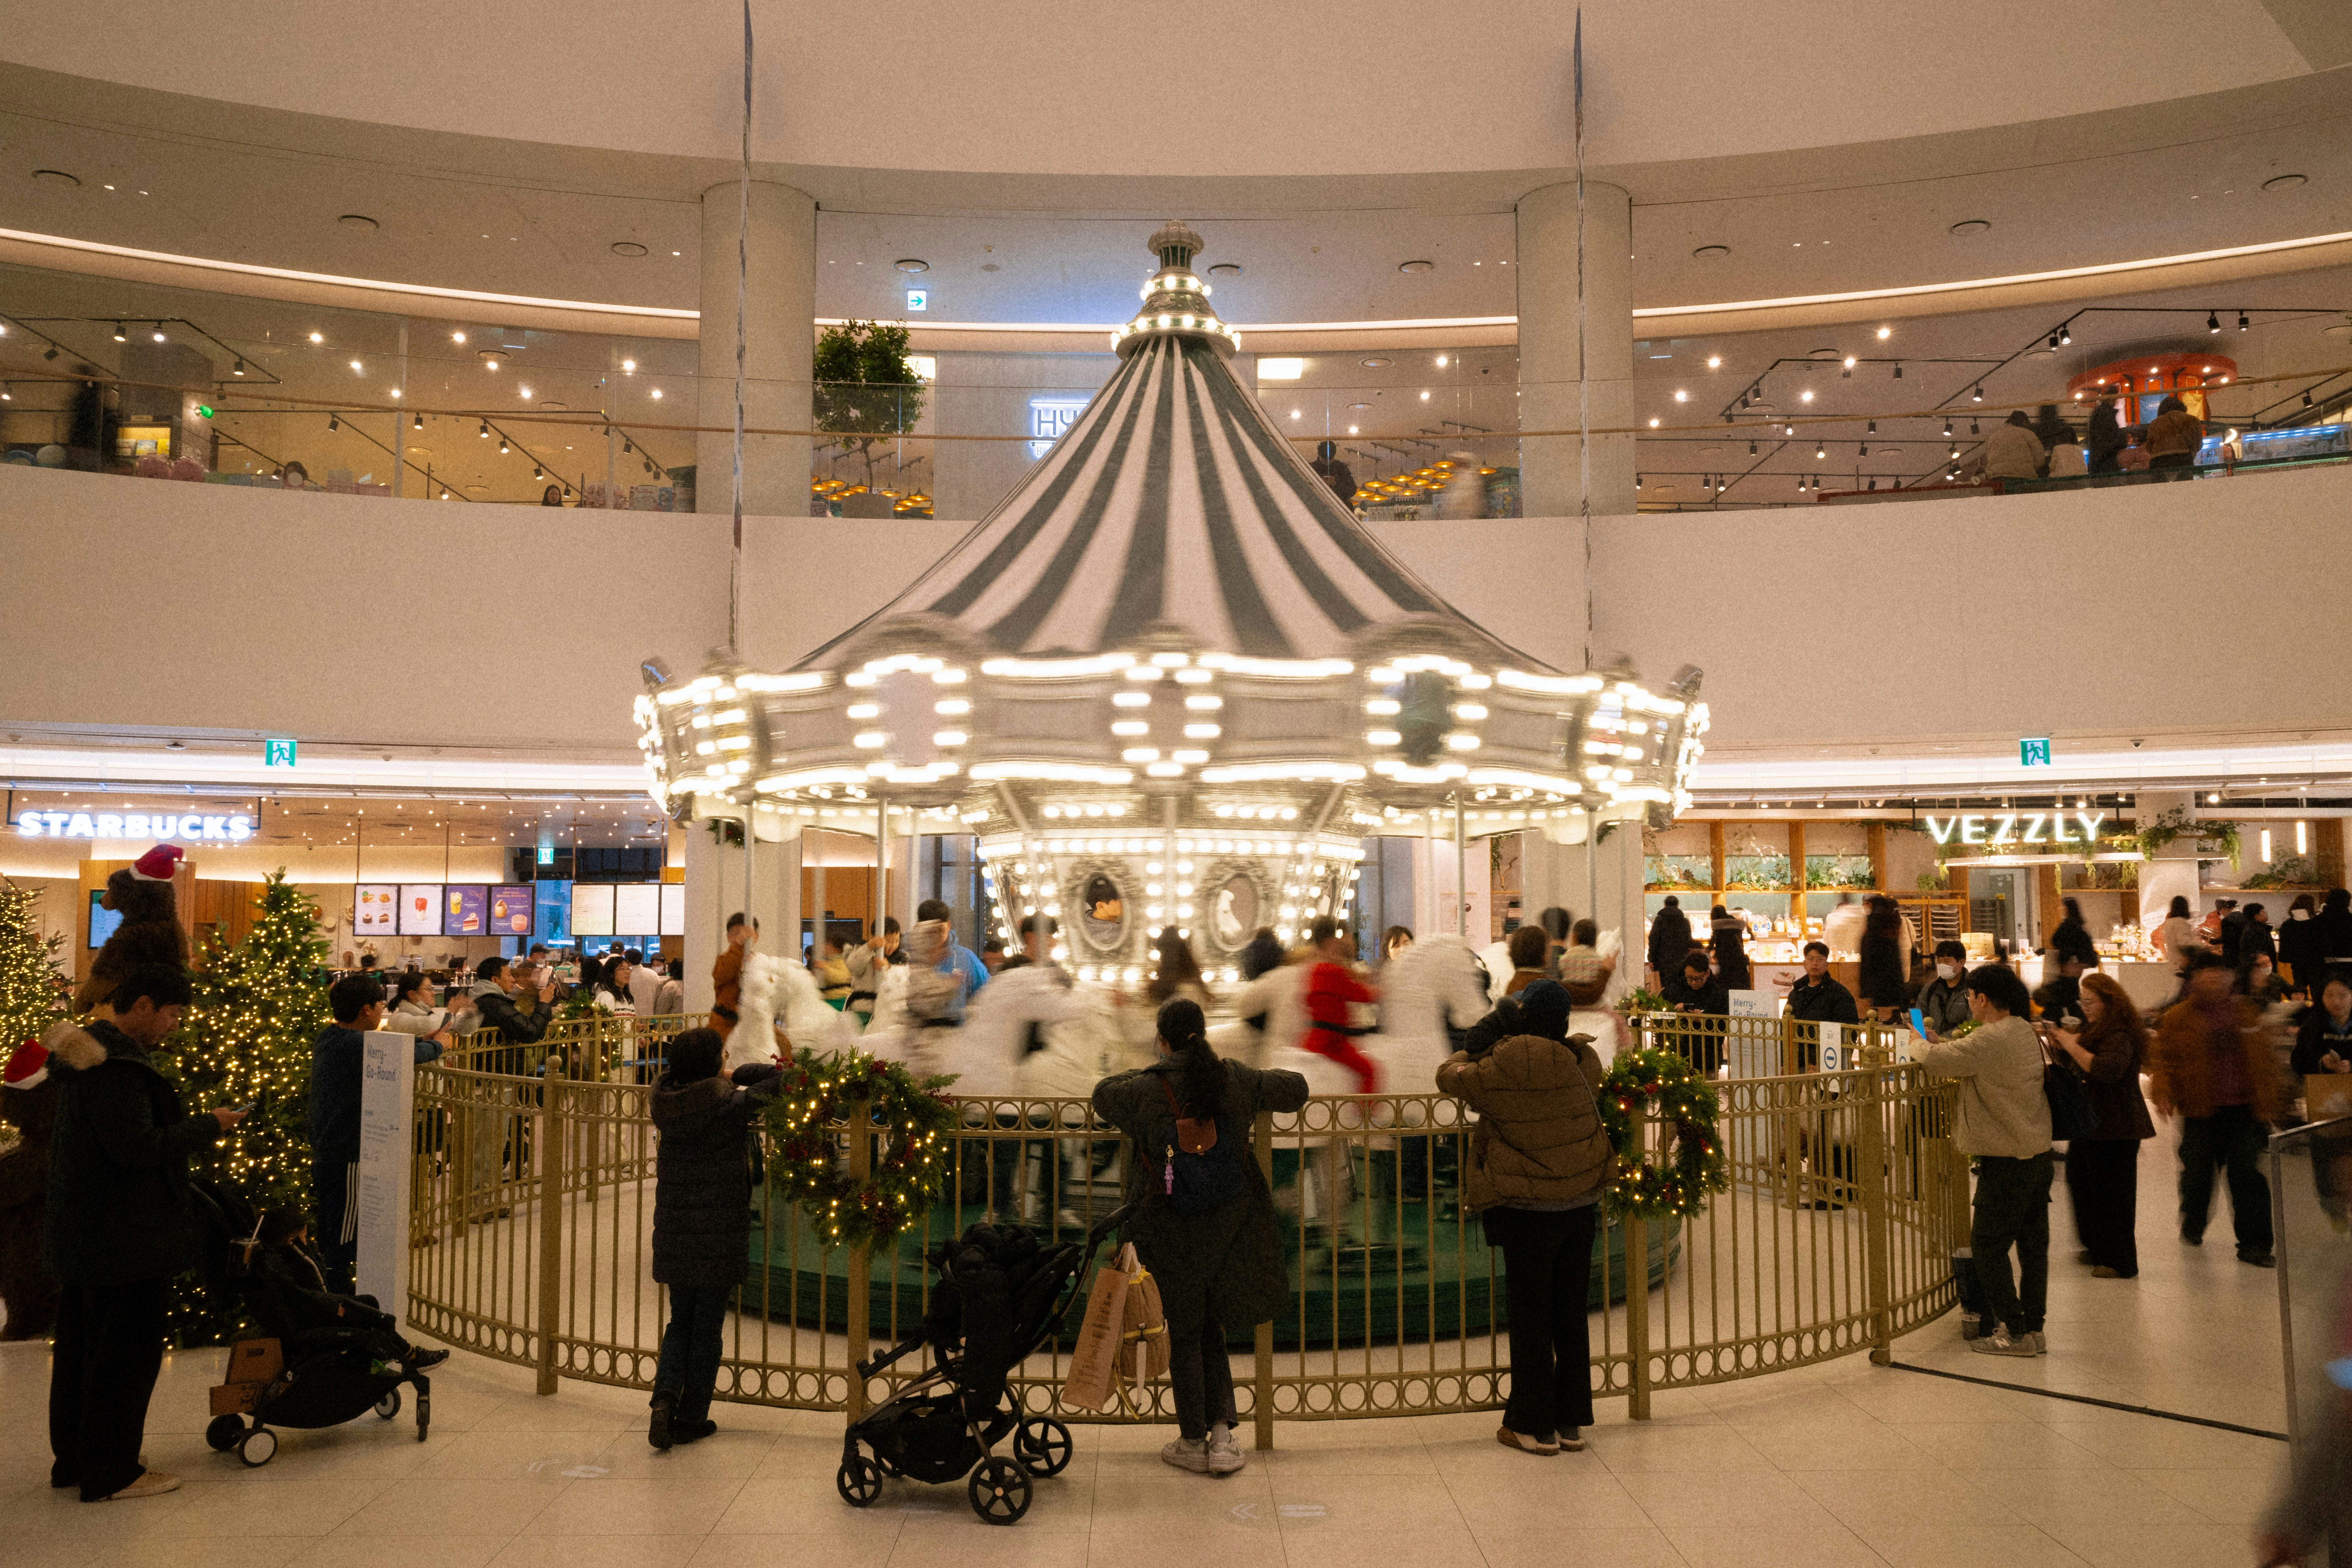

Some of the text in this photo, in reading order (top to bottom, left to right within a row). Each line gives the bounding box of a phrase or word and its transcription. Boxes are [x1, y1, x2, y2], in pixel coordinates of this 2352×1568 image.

[1038, 410, 1078, 436] HY
[18, 812, 252, 840] STARBUCKS
[1926, 812, 2104, 844] VEZZLY
[1733, 998, 1756, 1010] Merry-
[367, 1045, 387, 1065] Merry-
[366, 1064, 397, 1082] Go-Round
